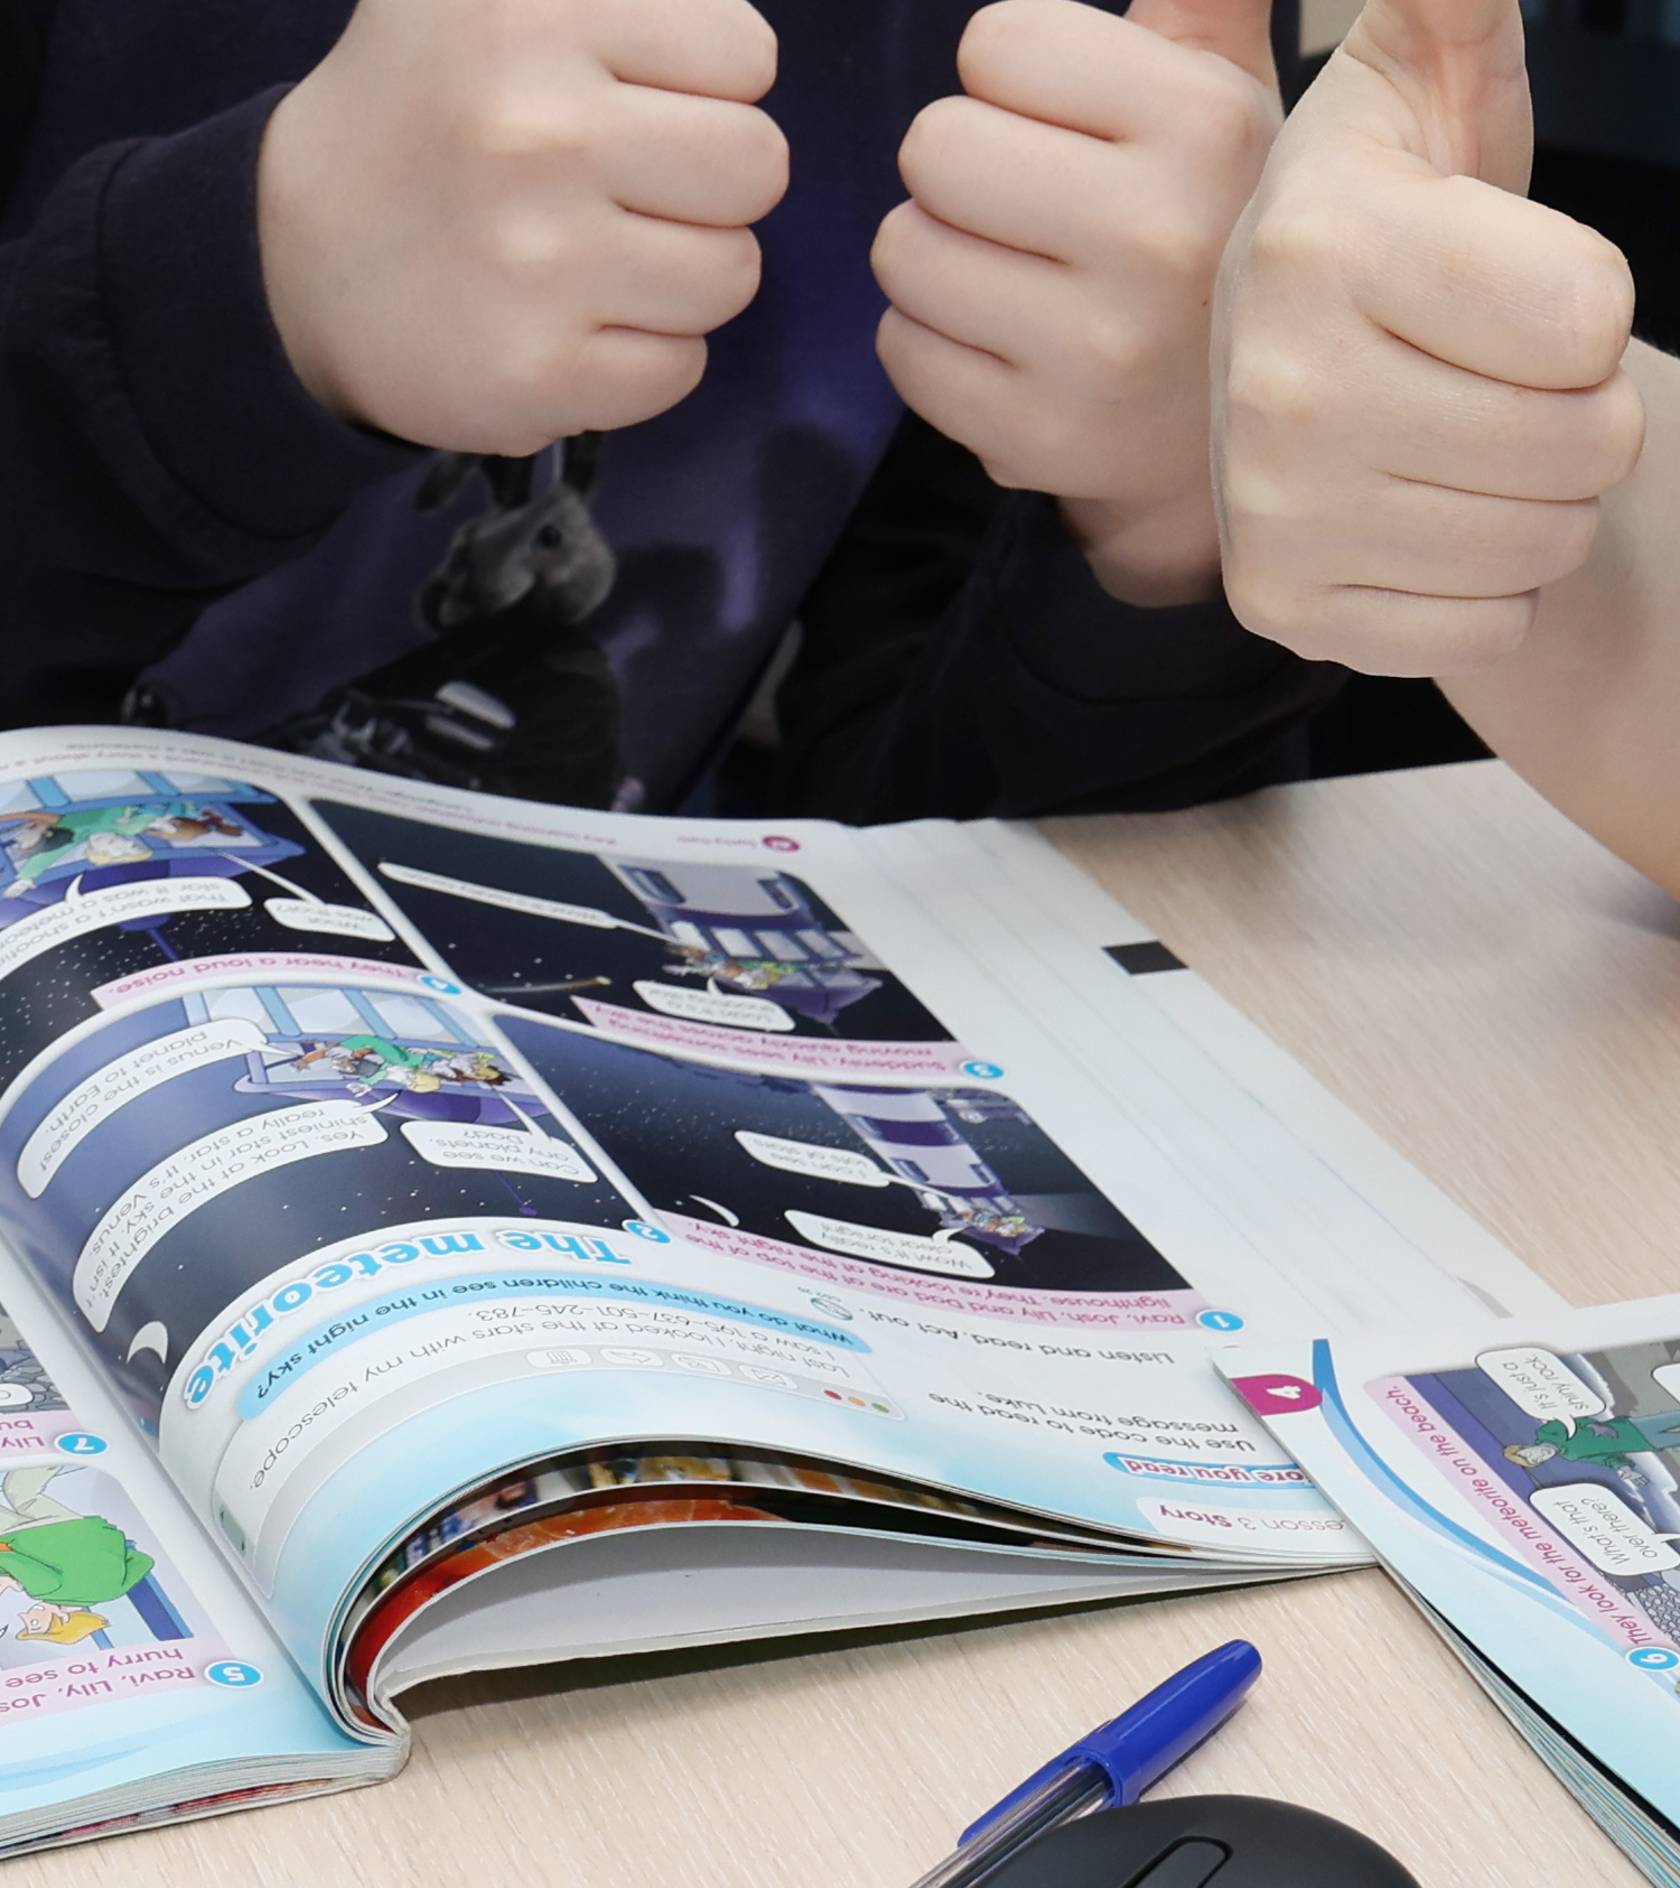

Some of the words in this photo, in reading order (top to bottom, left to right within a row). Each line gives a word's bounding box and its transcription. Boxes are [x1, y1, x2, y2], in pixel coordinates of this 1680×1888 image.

[499, 1231, 630, 1265] The
[421, 1288, 448, 1301] in
[451, 1280, 497, 1294] see
[502, 1278, 603, 1291] children
[608, 1282, 649, 1297] the
[374, 1296, 418, 1316] the
[652, 1289, 709, 1309] think
[711, 1301, 755, 1318] you
[757, 1312, 789, 1327] do
[859, 1308, 910, 1328] out.
[185, 1232, 481, 1408] meteorite
[307, 1314, 369, 1355] night
[750, 1331, 769, 1342] a
[793, 1322, 854, 1346] What
[916, 1322, 959, 1341] Act
[963, 1331, 1033, 1352] read.
[775, 1337, 822, 1356] saw
[825, 1350, 836, 1361] I
[1037, 1344, 1092, 1359] and
[1098, 1350, 1175, 1365] Listen
[1501, 1361, 1520, 1372] a
[1524, 1353, 1560, 1381] rock.
[257, 1353, 303, 1399] sky?
[1508, 1372, 1547, 1393] just
[928, 1392, 973, 1413] the
[1266, 1385, 1301, 1400] 4
[1533, 1392, 1559, 1411] It's
[1551, 1382, 1590, 1411] shiny
[978, 1392, 1047, 1416] Luke.
[1386, 1385, 1437, 1433] beach.
[976, 1404, 1040, 1425] read
[1050, 1406, 1113, 1427] from
[1117, 1415, 1239, 1433] message
[1045, 1419, 1075, 1434] to
[1079, 1425, 1148, 1443] code
[0, 1435, 45, 1449] Lily
[68, 1436, 94, 1453] 7
[1154, 1435, 1201, 1451] the
[1205, 1438, 1256, 1452] Use
[1429, 1434, 1459, 1457] the
[1122, 1459, 1188, 1477] read
[1195, 1467, 1250, 1482] you
[1451, 1457, 1478, 1477] on
[1159, 1504, 1233, 1528] Story
[1471, 1478, 1542, 1540] meteorite
[1553, 1500, 1589, 1525] that
[1580, 1497, 1630, 1533] there?
[1236, 1516, 1257, 1531] 3
[1261, 1518, 1346, 1532] esson
[1534, 1542, 1566, 1565] the
[1582, 1525, 1631, 1566] What's
[1622, 1534, 1659, 1559] over
[1557, 1565, 1587, 1584] for
[1577, 1584, 1619, 1614] look
[1610, 1614, 1653, 1645] They
[107, 1647, 184, 1668] hurry
[1638, 1650, 1670, 1668] 6
[66, 1661, 99, 1675] to
[121, 1666, 196, 1687] Ravi,
[222, 1664, 247, 1684] 5
[5, 1669, 59, 1689] see
[57, 1679, 113, 1698] Lily,
